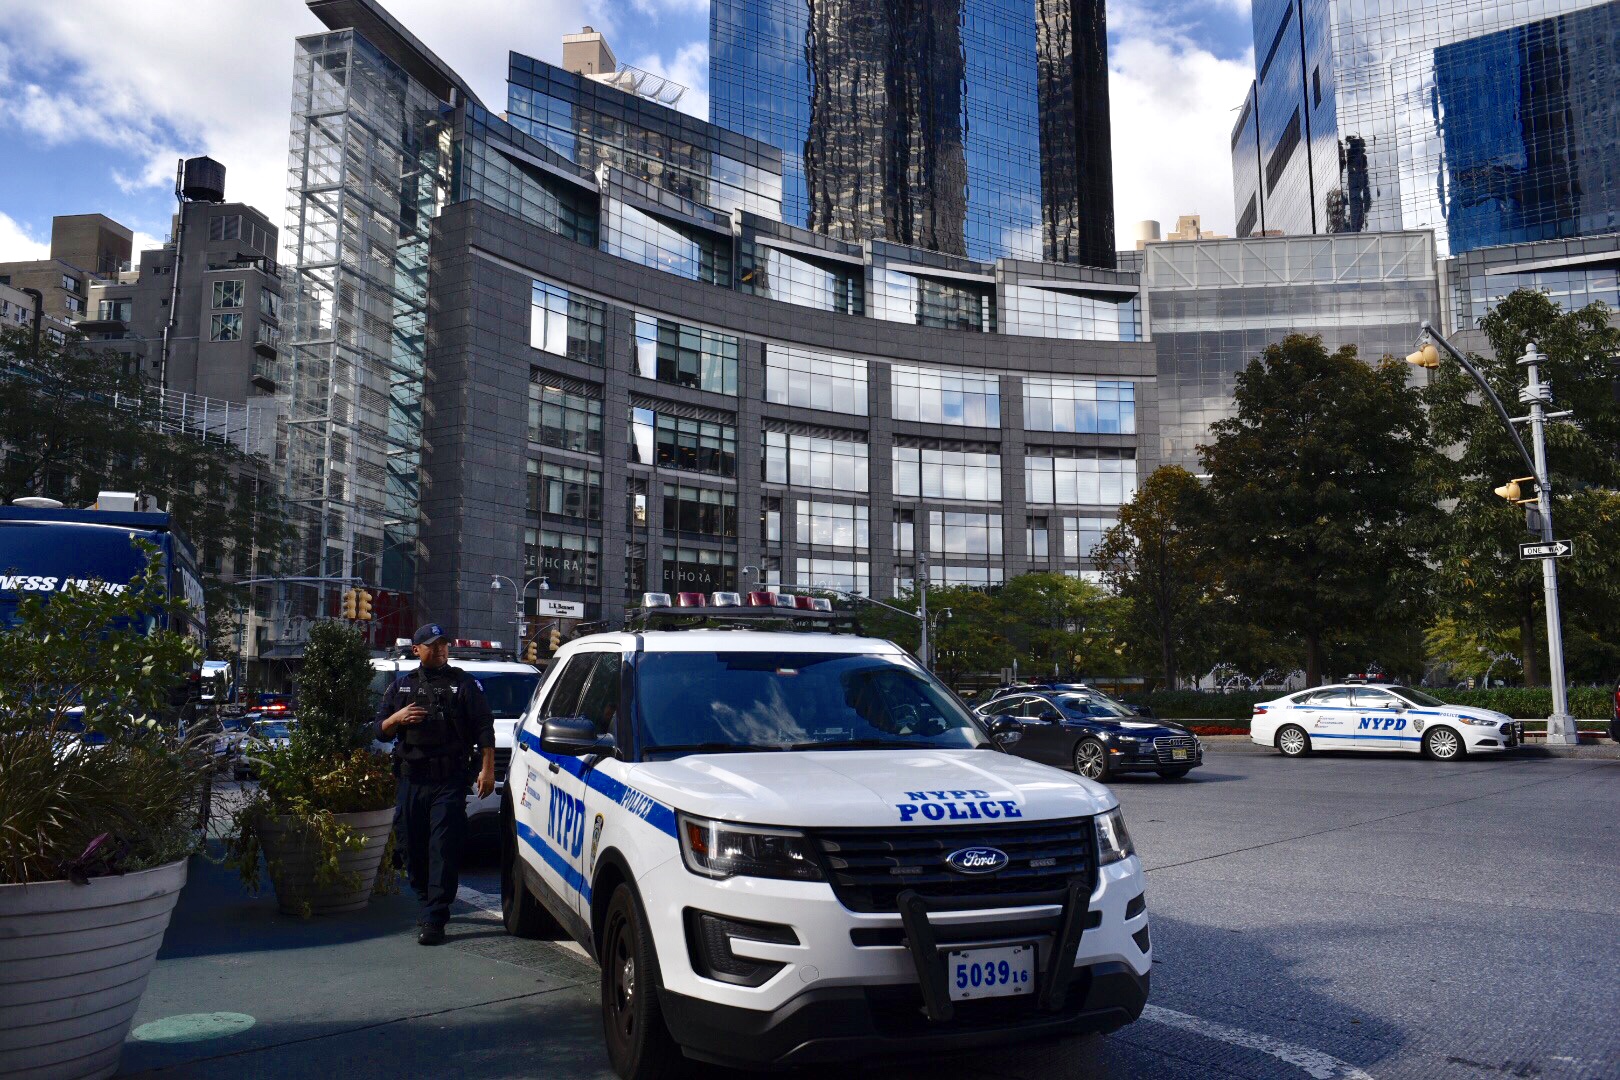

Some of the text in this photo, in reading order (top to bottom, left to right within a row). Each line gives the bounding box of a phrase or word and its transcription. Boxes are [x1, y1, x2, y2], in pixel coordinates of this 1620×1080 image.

[1527, 545, 1564, 555] ONE WAY
[1358, 717, 1407, 731] NYPD
[623, 785, 654, 819] POLICE
[903, 789, 991, 801] NYPD
[547, 783, 586, 859] NYPD
[895, 800, 1022, 822] POLICE
[963, 850, 997, 868] Ford
[956, 960, 1028, 989] 5039 16
